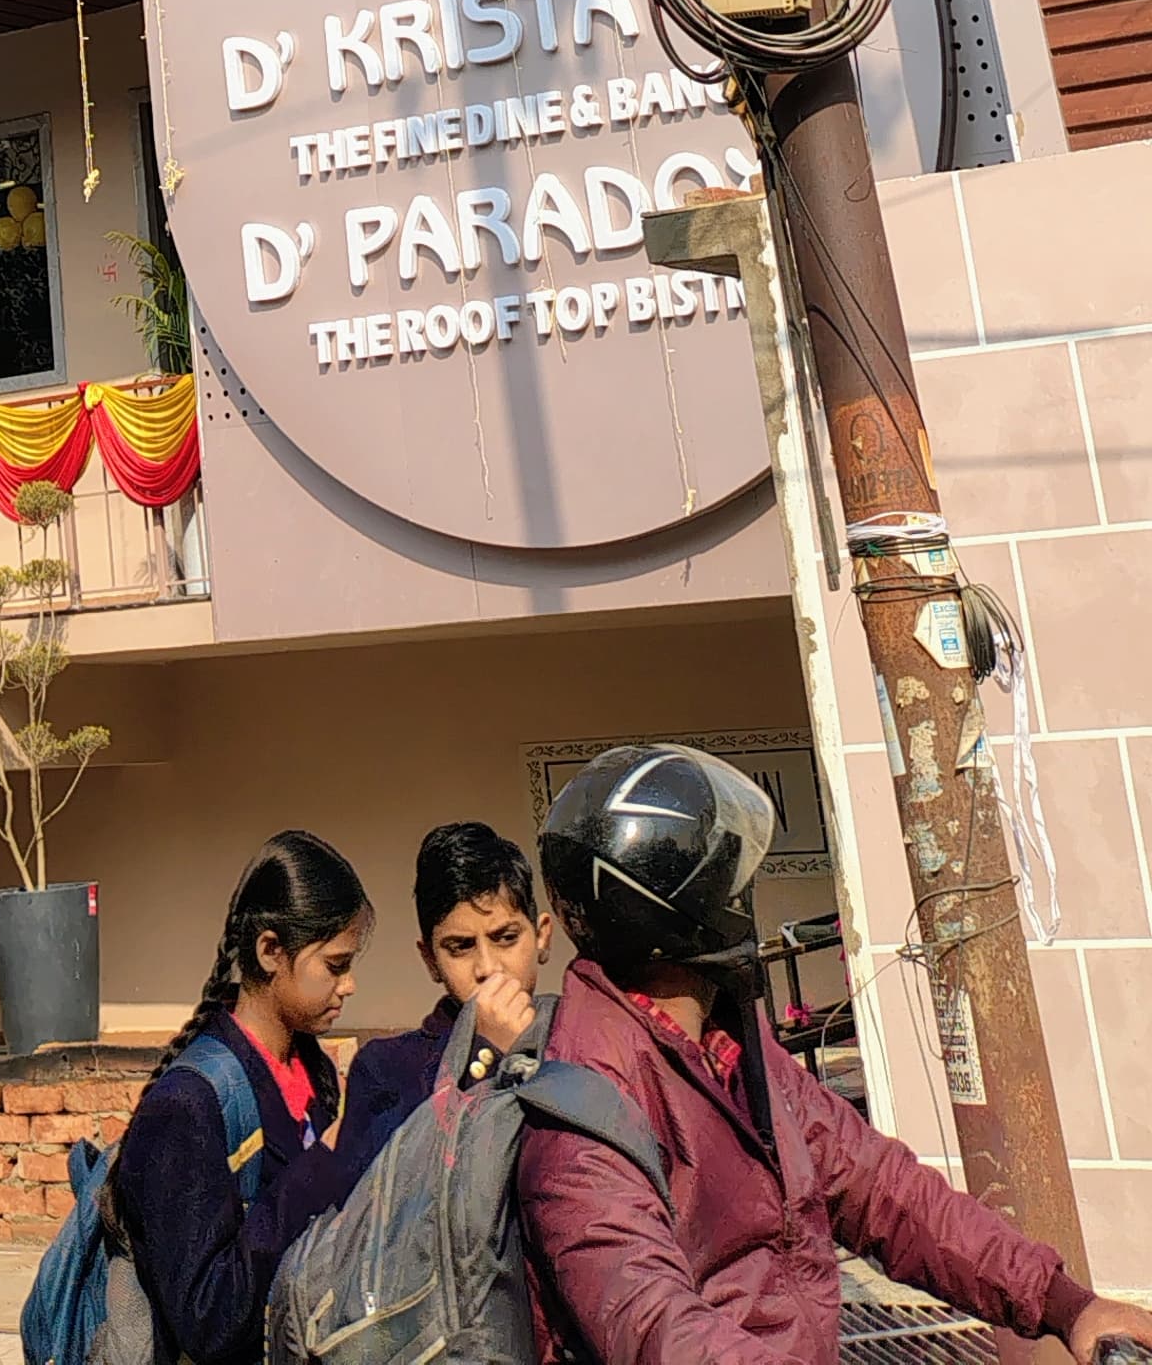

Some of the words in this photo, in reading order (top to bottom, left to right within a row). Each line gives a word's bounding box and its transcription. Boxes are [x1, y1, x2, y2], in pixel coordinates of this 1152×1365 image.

[222, 32, 295, 111] D'
[290, 132, 371, 176] THE
[375, 109, 464, 164] FINE
[465, 91, 565, 147] DINE
[570, 84, 604, 127] &
[241, 221, 314, 302] D'
[308, 312, 394, 364] THE
[397, 295, 520, 354] ROOF
[526, 282, 618, 336] TOP
